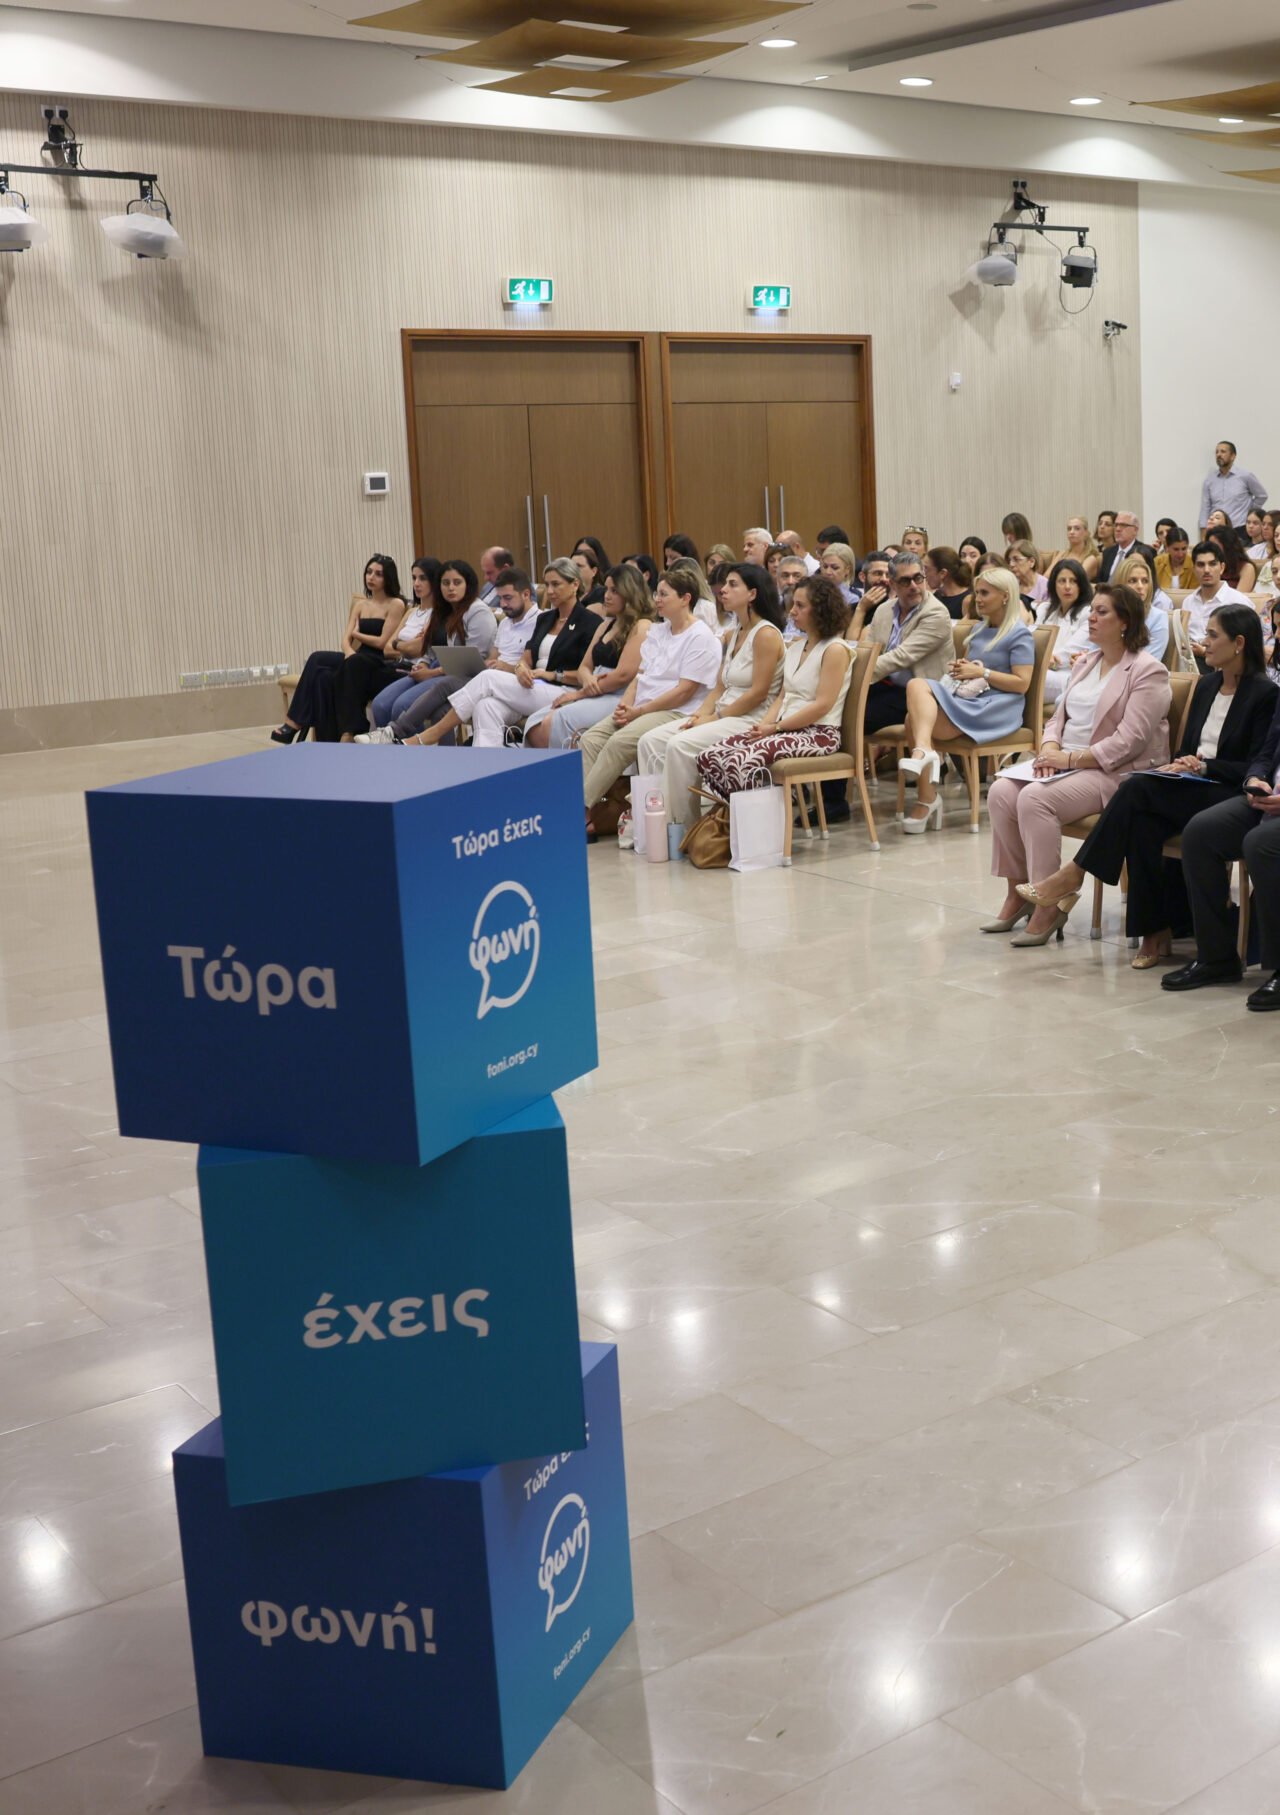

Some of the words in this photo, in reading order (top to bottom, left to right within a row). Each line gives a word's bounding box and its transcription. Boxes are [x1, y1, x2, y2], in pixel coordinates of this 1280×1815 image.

[451, 829, 500, 859] Τώρα
[503, 814, 542, 843] έχεις
[468, 905, 541, 971] φωνή
[167, 944, 337, 1015] Τώρα
[486, 1042, 539, 1079] foni.org.cy
[303, 1288, 490, 1348] έχεις
[524, 1455, 559, 1501] Τώρα
[537, 1503, 591, 1590] φωνή
[240, 1600, 437, 1655] φωνή!
